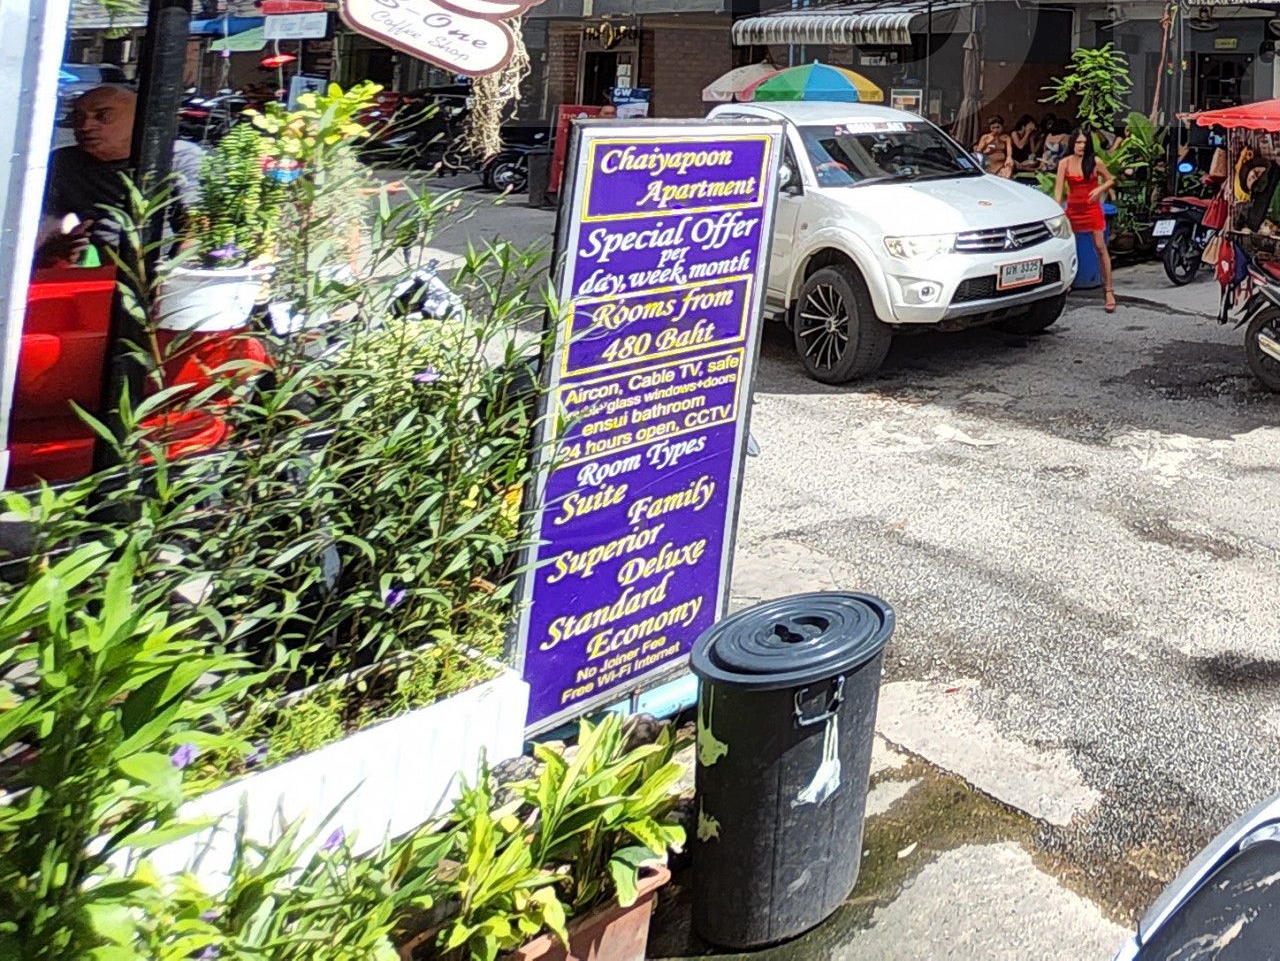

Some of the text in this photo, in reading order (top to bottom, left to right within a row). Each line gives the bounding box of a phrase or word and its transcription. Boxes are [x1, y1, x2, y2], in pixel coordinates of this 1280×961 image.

[371, 10, 470, 62] Coffee Shop
[600, 146, 733, 176] Chaiyapoon
[636, 175, 756, 208] Apartment
[579, 212, 758, 262] Special Offer
[657, 246, 690, 268] per
[592, 287, 734, 330] Rooms from
[602, 319, 715, 363] 480 Baht
[565, 383, 623, 407] Aircon,
[628, 371, 675, 391] Cable
[708, 356, 740, 373] safe
[606, 395, 641, 414] glass
[644, 373, 737, 402] windows+doors
[557, 445, 581, 463] 24
[585, 432, 631, 455] hours
[684, 404, 732, 428] CCTV
[631, 395, 706, 424] bathroom
[577, 434, 707, 487] Room Types
[553, 482, 629, 525] Suite
[627, 475, 715, 525] Family
[546, 523, 665, 584] Superior
[617, 538, 707, 586] Deluxe
[539, 571, 676, 651] Standard
[587, 595, 704, 661] Economy
[561, 641, 681, 705] Free Wi-Fi Internet
[577, 635, 667, 684] No Joiner Fee
